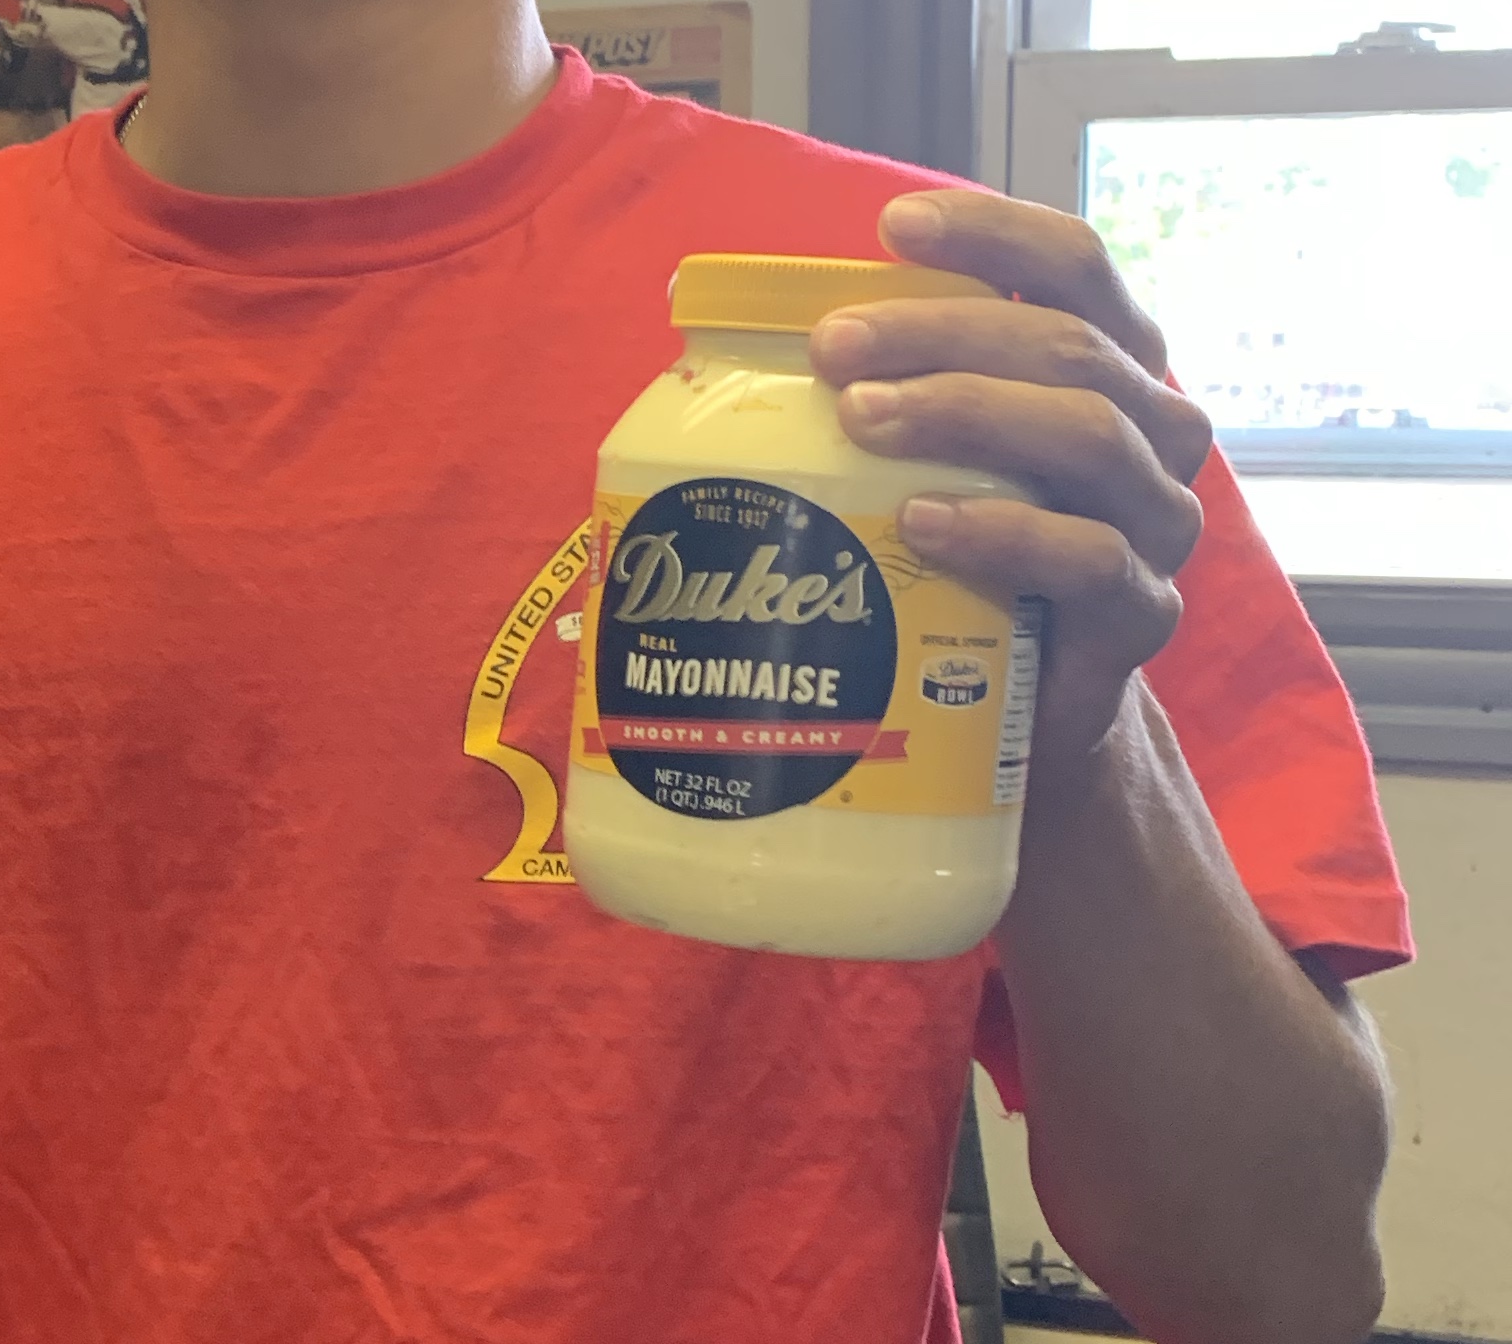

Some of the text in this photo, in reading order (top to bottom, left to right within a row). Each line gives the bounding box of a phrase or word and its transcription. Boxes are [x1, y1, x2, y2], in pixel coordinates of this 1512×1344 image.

[681, 486, 786, 515] FAMILY RECIPE
[694, 502, 770, 531] SINCE 1917
[613, 529, 871, 626] Duke's
[481, 530, 592, 700] UNITED STA
[638, 632, 677, 653] REAL
[624, 651, 841, 708] MAYONNAISE
[937, 687, 975, 704] BOWL
[623, 725, 843, 746] SMOOTH & CREAMY
[654, 768, 752, 798] NET 32 FL OZ
[735, 799, 746, 816] L
[522, 858, 574, 878] CAM
